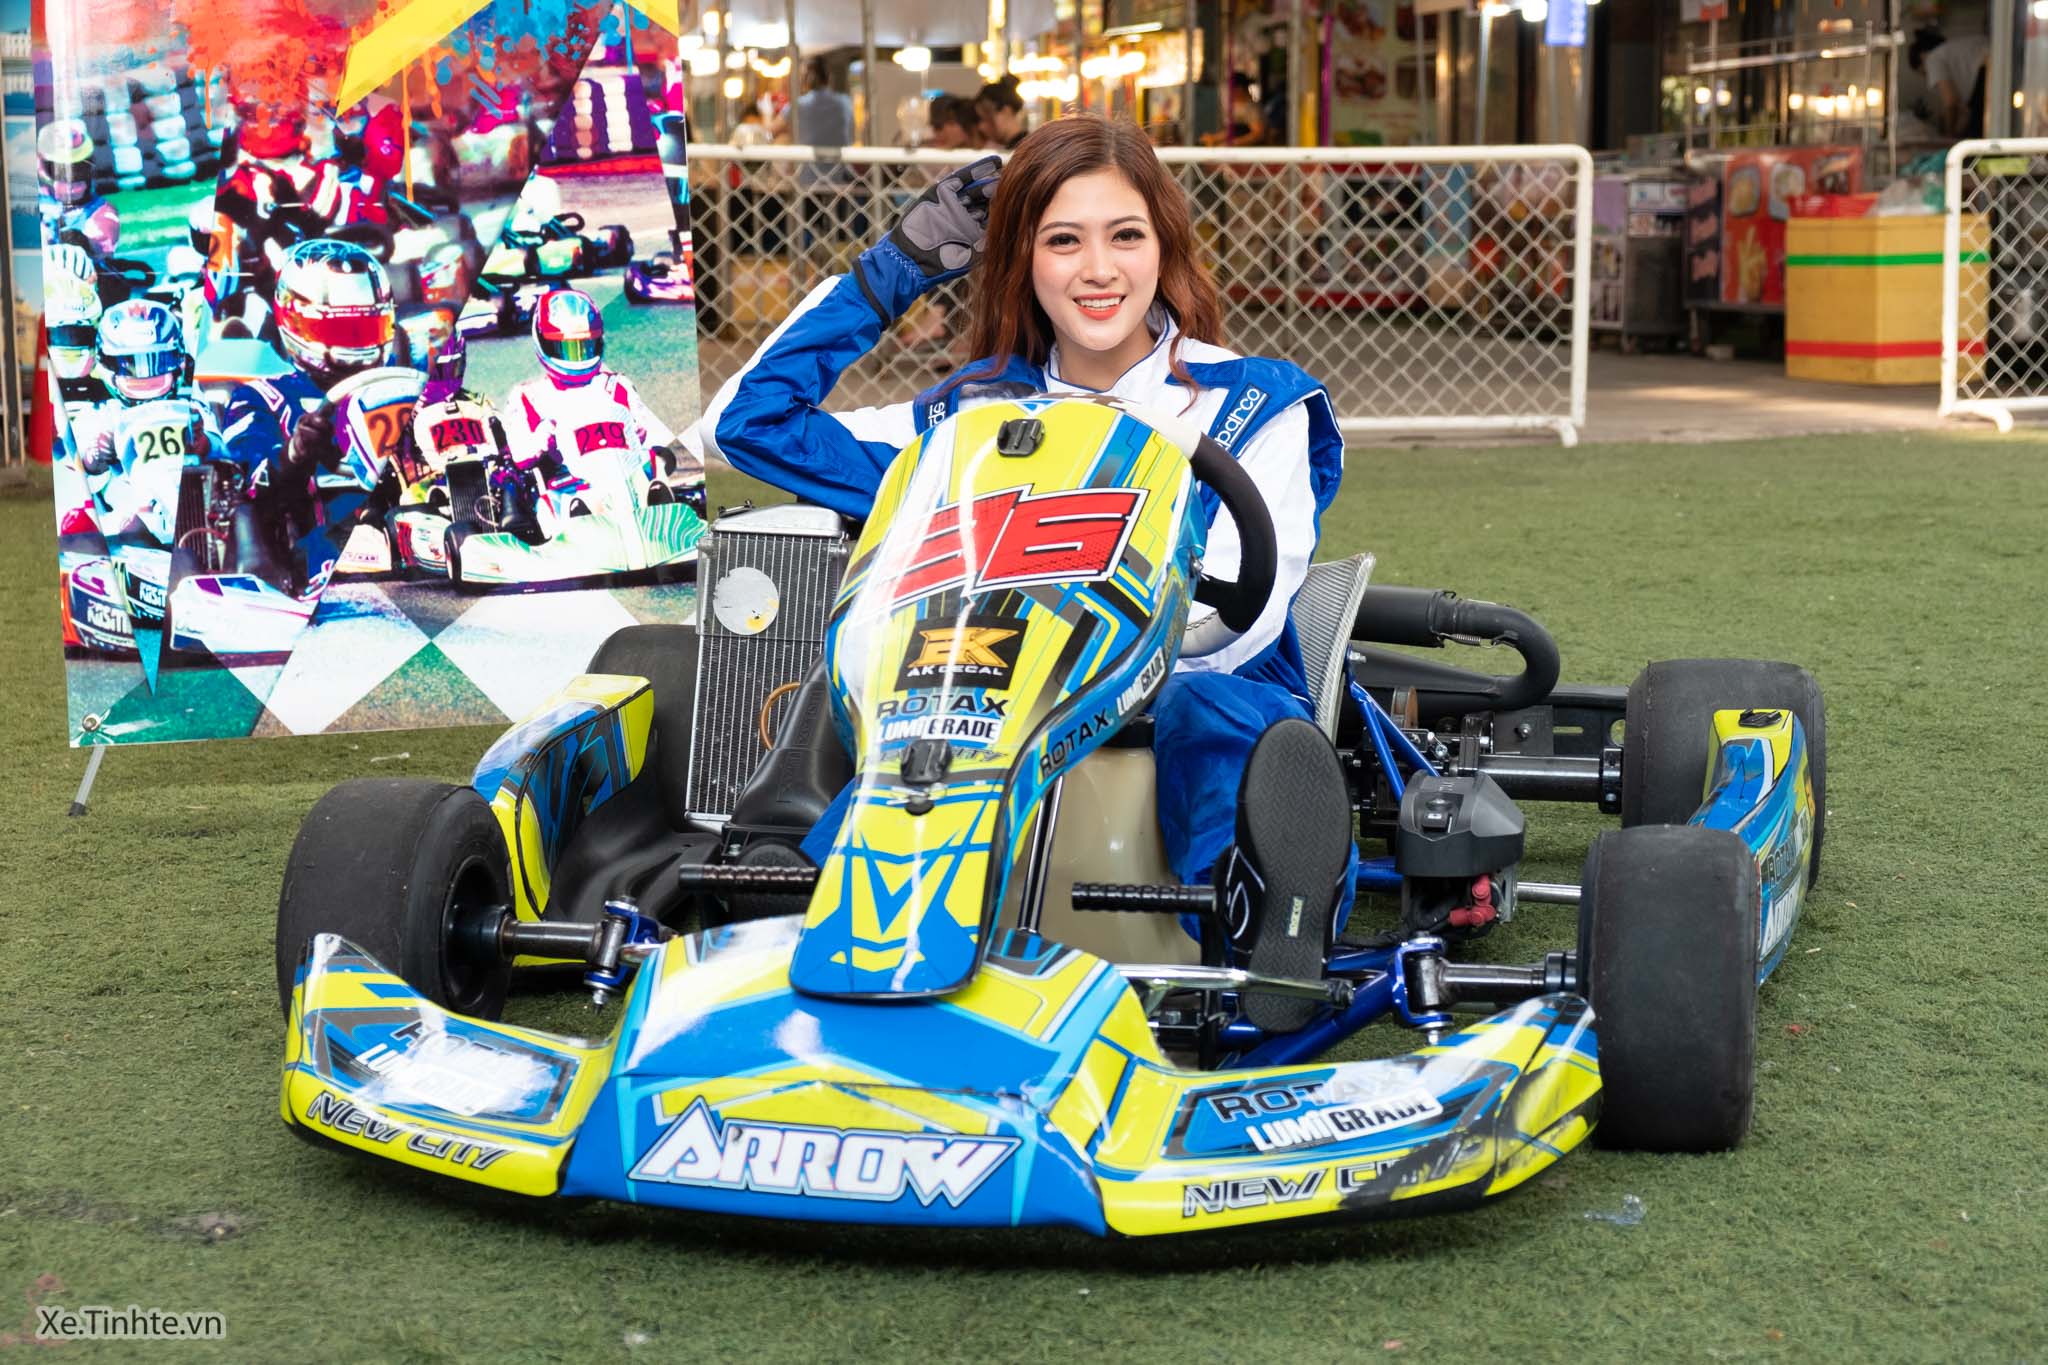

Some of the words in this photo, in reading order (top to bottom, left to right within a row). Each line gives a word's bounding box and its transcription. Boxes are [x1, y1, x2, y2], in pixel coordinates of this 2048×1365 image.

[431, 419, 485, 449] 230
[576, 422, 627, 454] 219
[1214, 388, 1260, 451] parco
[876, 694, 1009, 718] ROTAX
[1040, 708, 1110, 777] ROTAX
[306, 1090, 404, 1142] NEW
[407, 1127, 512, 1170] CITY
[628, 1095, 1022, 1207] ARROW
[1183, 1168, 1328, 1217] NEW
